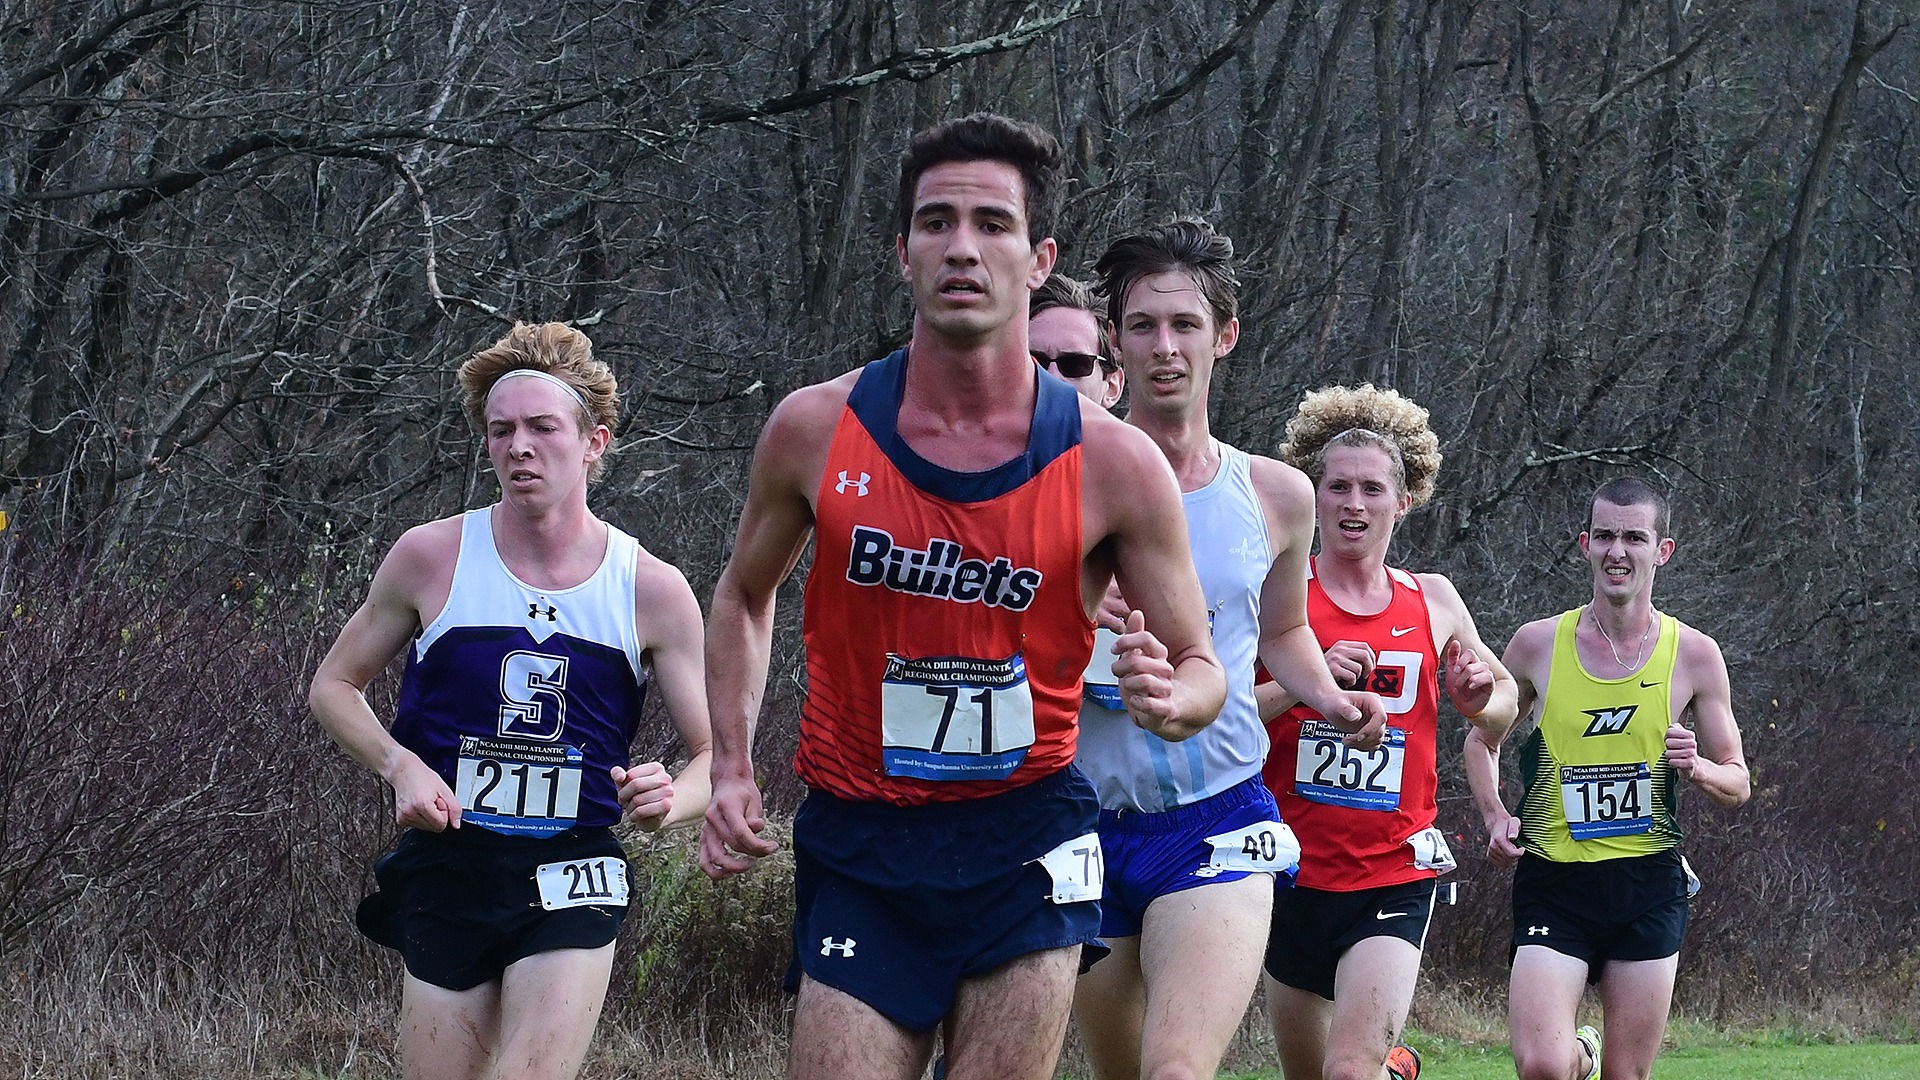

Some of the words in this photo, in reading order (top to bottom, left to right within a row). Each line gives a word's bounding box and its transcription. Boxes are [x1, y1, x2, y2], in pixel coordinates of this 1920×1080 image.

[846, 524, 1043, 612] Bullets
[904, 670, 950, 681] REGIONAL
[950, 672, 1015, 684] CHAMPIONSHIP
[933, 661, 950, 670] DIII
[951, 661, 970, 671] MID
[970, 662, 1011, 672] ATLANTIC
[497, 649, 569, 742] S
[925, 684, 993, 756] 71
[476, 749, 512, 759] REGIONAL
[513, 752, 566, 763] CHAMPIONSHIP
[480, 740, 499, 749] NCAA
[529, 746, 564, 755] ATLANTIC
[1312, 738, 1390, 793] 252
[472, 758, 561, 819] 211
[1575, 779, 1642, 824] 154
[1072, 846, 1101, 886] 71
[1241, 830, 1276, 862] 40
[563, 860, 613, 901] 211
